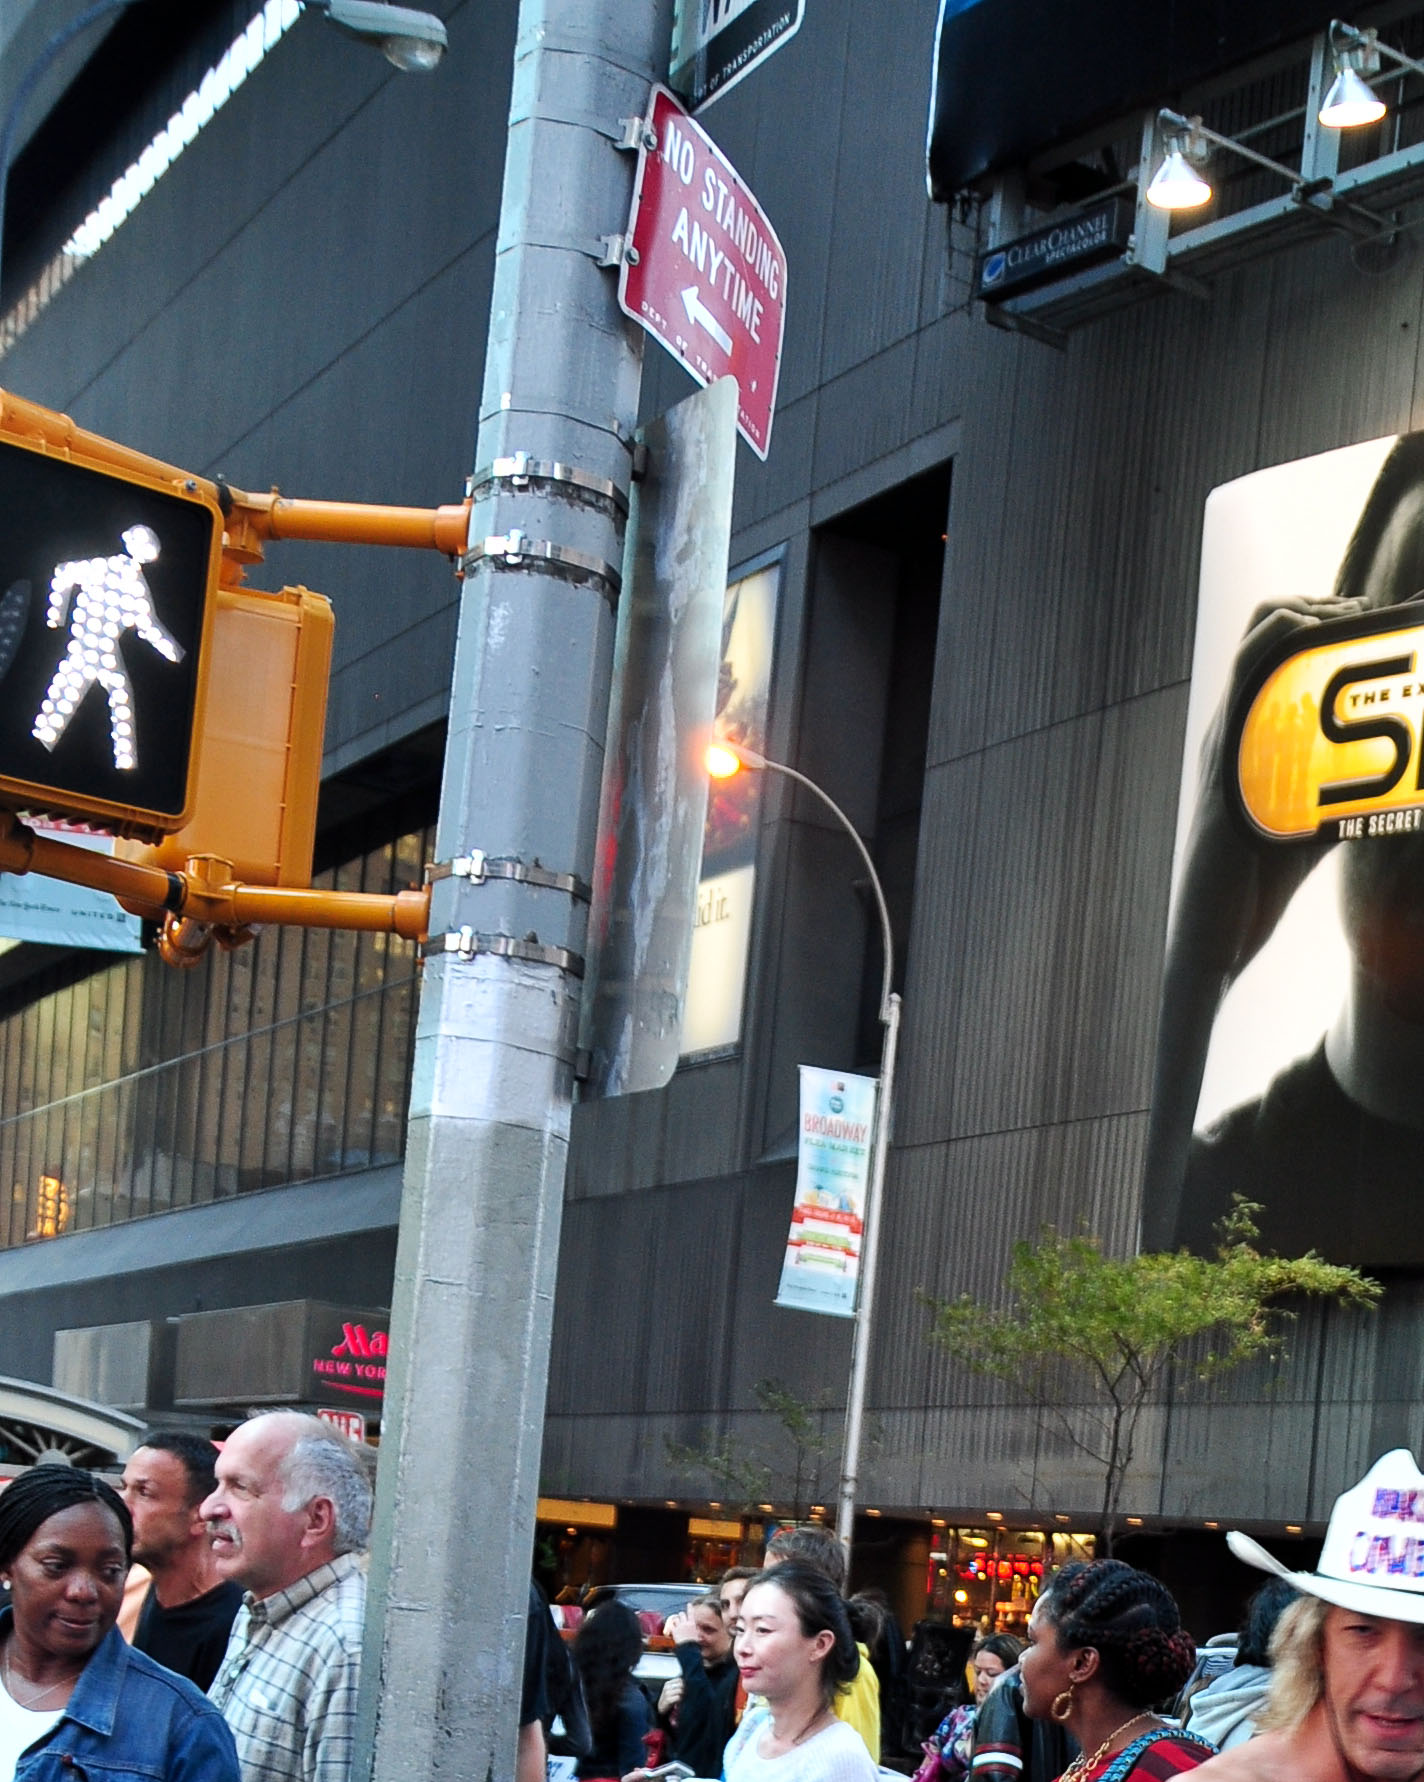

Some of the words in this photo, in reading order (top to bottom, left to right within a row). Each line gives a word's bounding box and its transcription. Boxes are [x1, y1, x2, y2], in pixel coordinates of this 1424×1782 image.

[723, 11, 790, 78] TRANSPORTATION
[662, 120, 695, 186] NO
[702, 166, 781, 301] STANDING
[671, 206, 764, 345] ANYTIME
[641, 300, 668, 330] DEPT
[675, 335, 688, 352] OF
[1349, 687, 1391, 708] THE
[1338, 815, 1363, 841] THE
[1367, 807, 1422, 837] SECRET
[804, 1111, 867, 1143] BROADWAY
[313, 1359, 352, 1376] NEW
[355, 1363, 388, 1380] YOR
